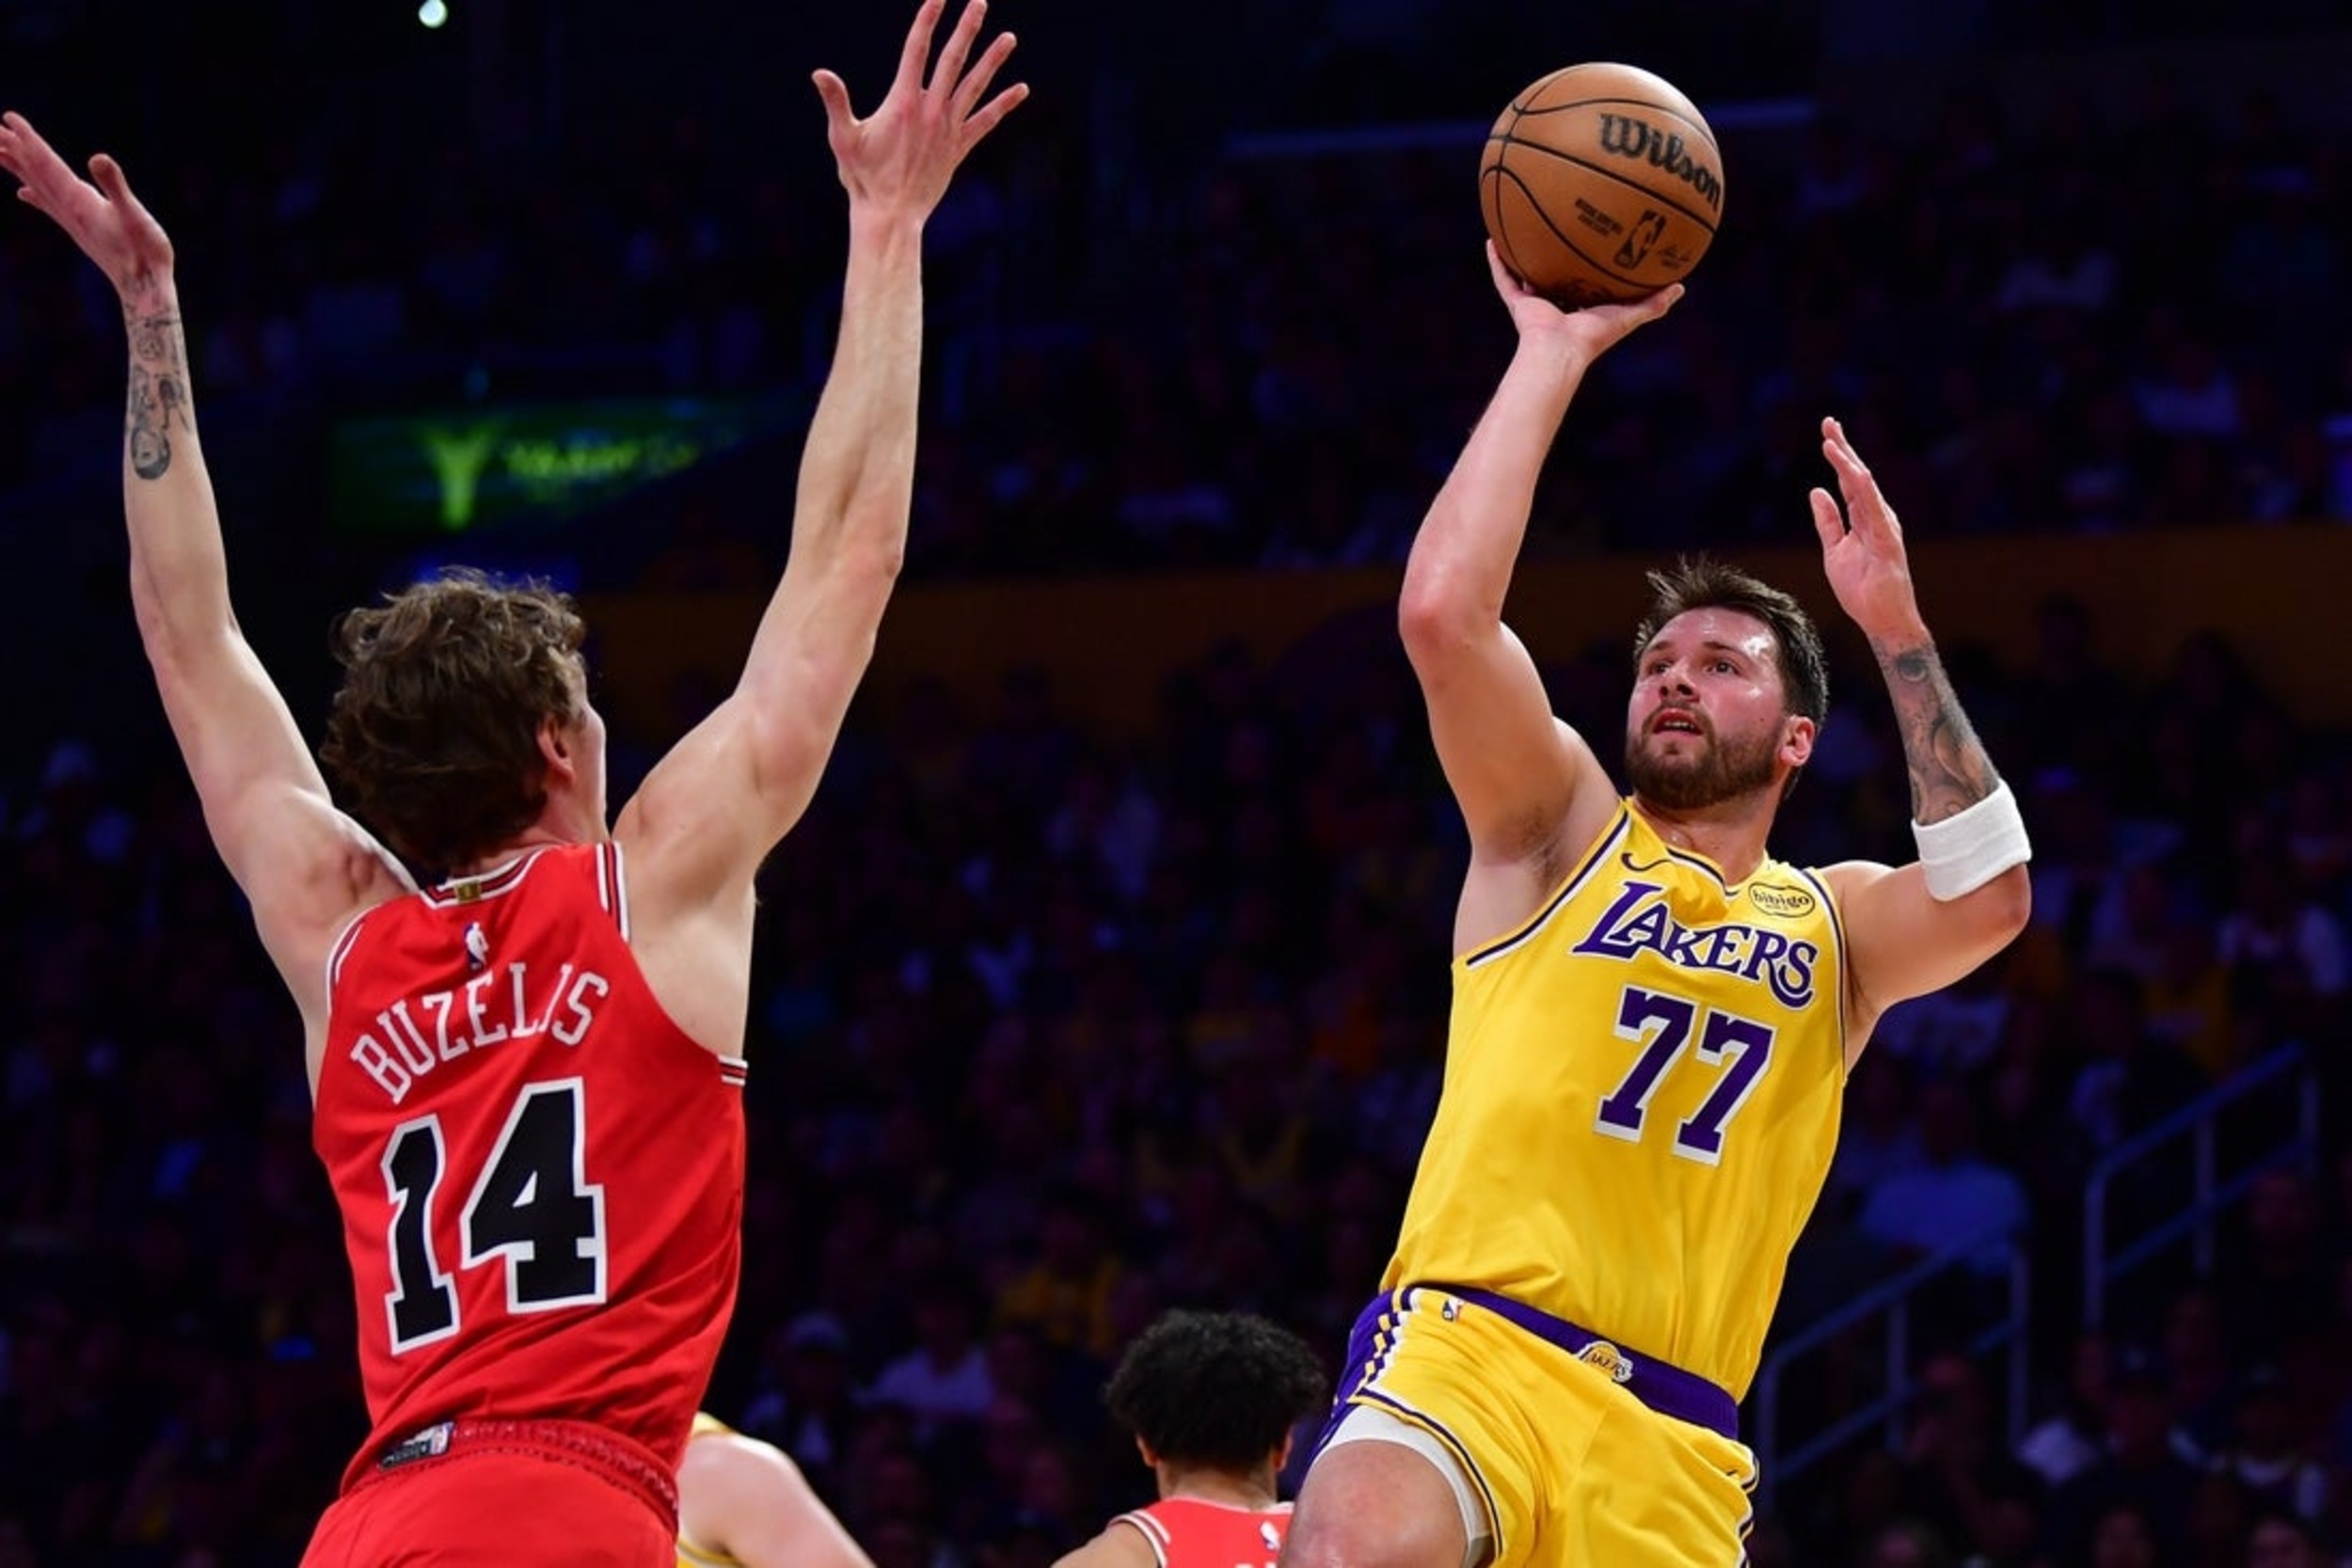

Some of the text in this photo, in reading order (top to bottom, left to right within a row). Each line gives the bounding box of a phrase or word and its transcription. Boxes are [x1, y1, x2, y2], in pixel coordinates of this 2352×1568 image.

[1599, 112, 1721, 212] Wilson
[1571, 880, 1819, 1009] LAKERS
[1752, 889, 1810, 909] bibigo
[350, 962, 610, 1104] BUZELIS
[1593, 984, 1778, 1166] 77
[381, 1076, 608, 1356] 14
